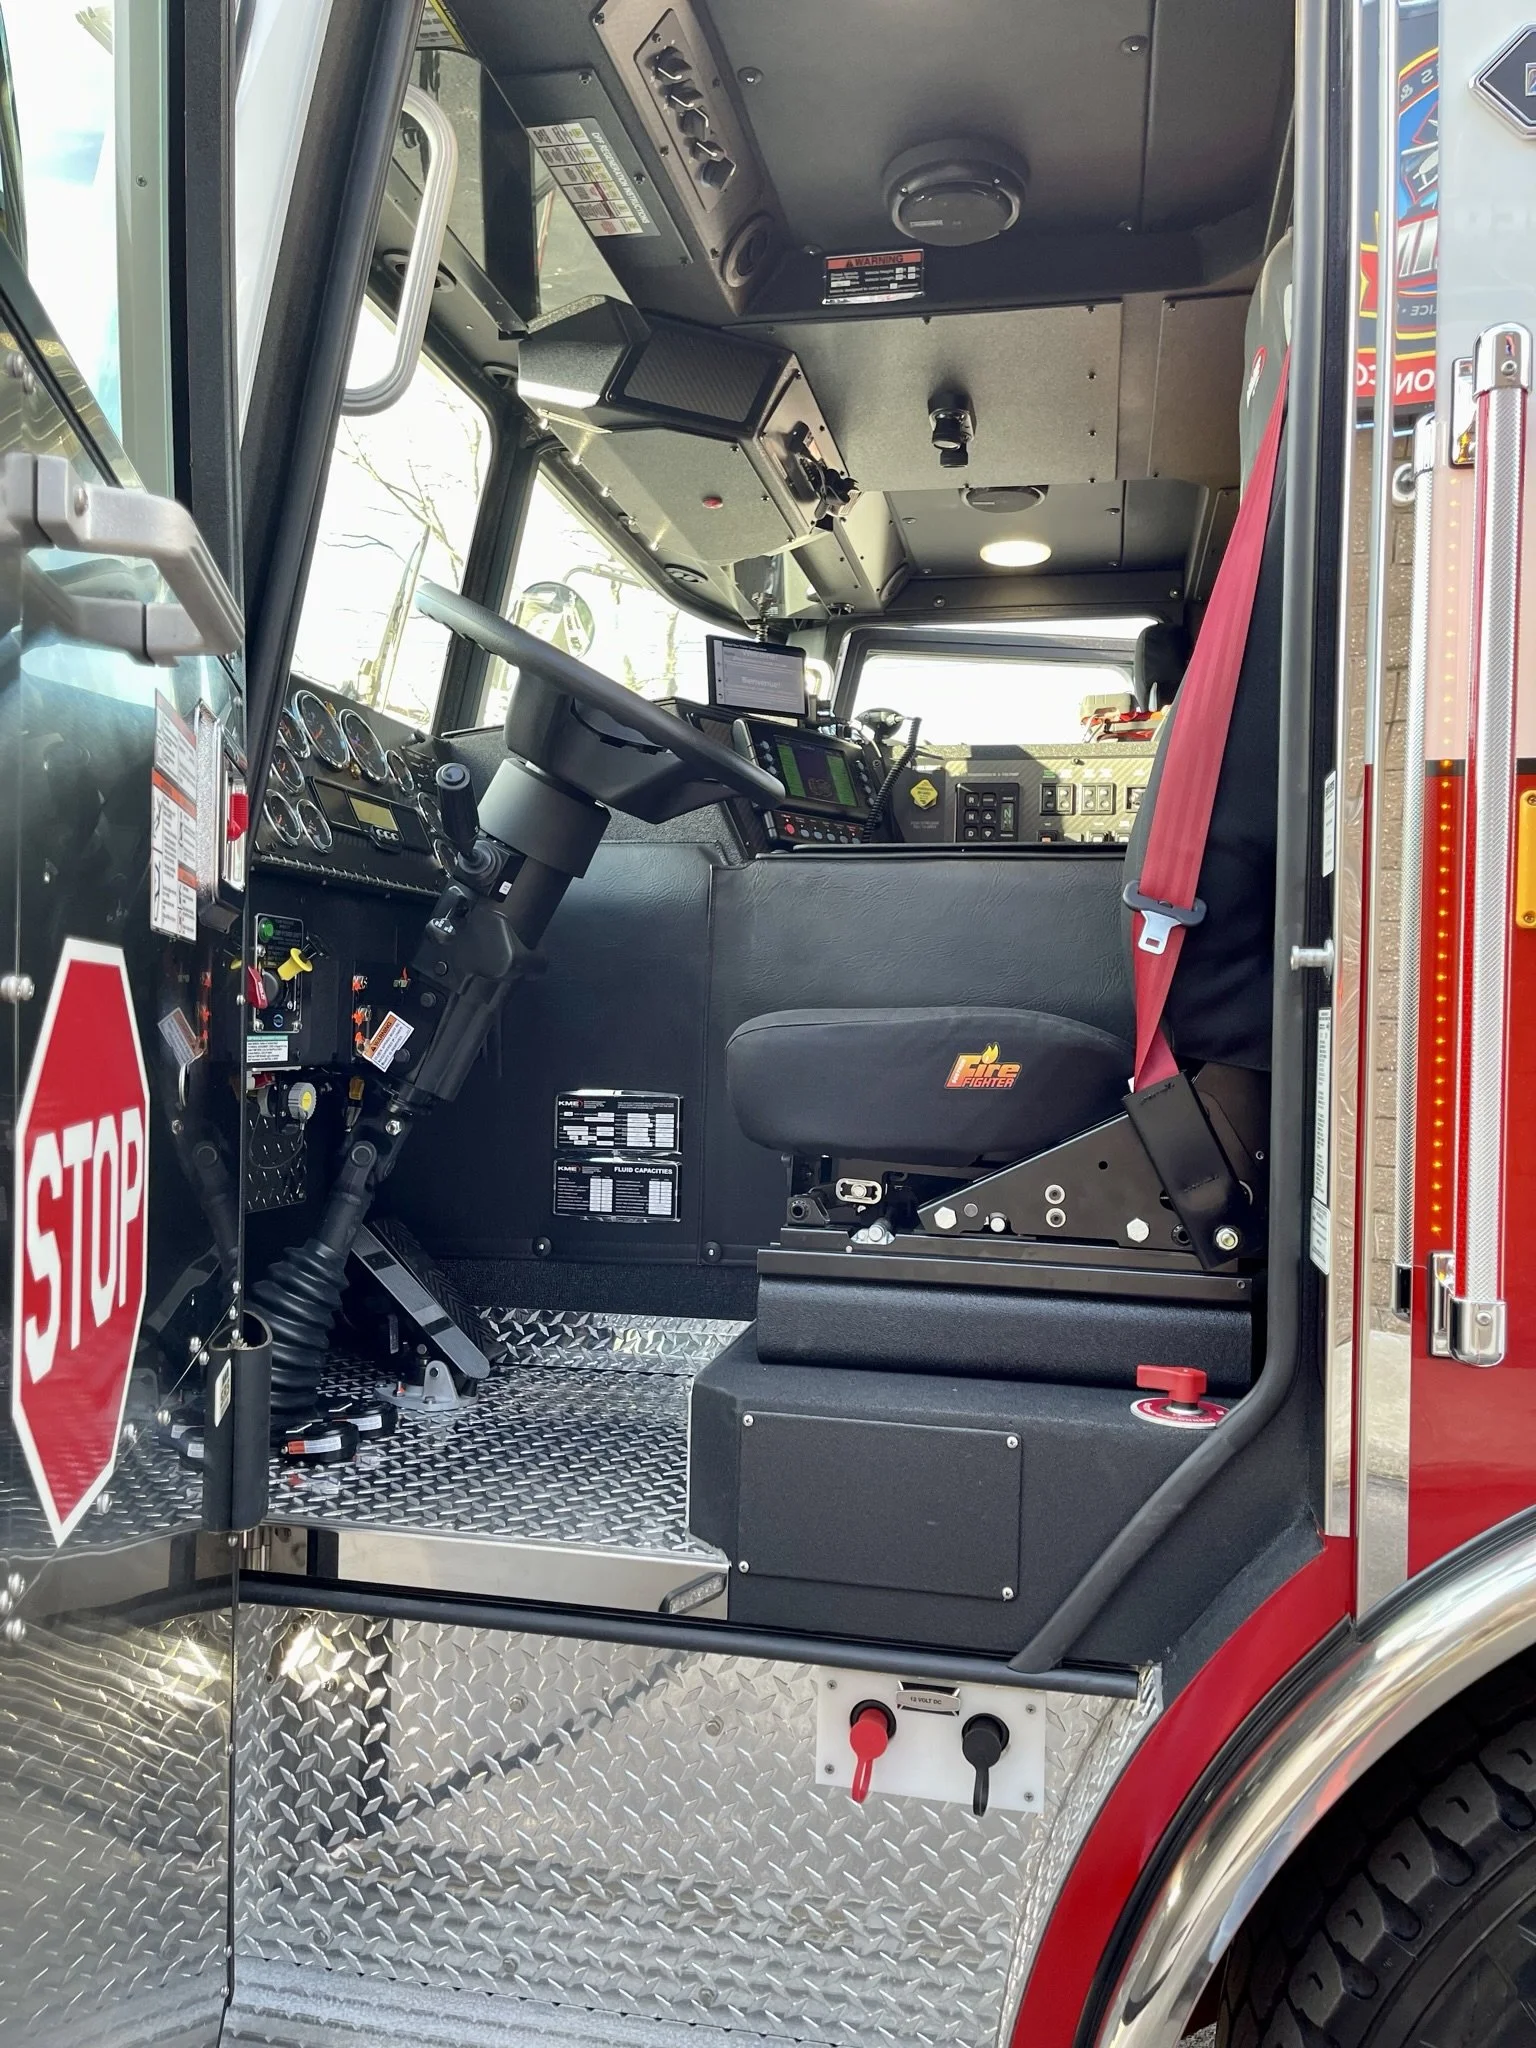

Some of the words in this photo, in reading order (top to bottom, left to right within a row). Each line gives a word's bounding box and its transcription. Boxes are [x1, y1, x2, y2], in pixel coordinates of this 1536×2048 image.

[591, 132, 602, 145] DPF
[599, 144, 627, 187] REGENERATION
[624, 185, 651, 224] INSTRUCTIONS
[855, 254, 904, 267] WARNING
[968, 796, 975, 804] R
[374, 1021, 392, 1047] WARNING
[946, 1054, 1021, 1088] Fire
[961, 1077, 1015, 1088] FIGHTER
[634, 1167, 673, 1175] CAPACITIES
[25, 1106, 144, 1385] STOP
